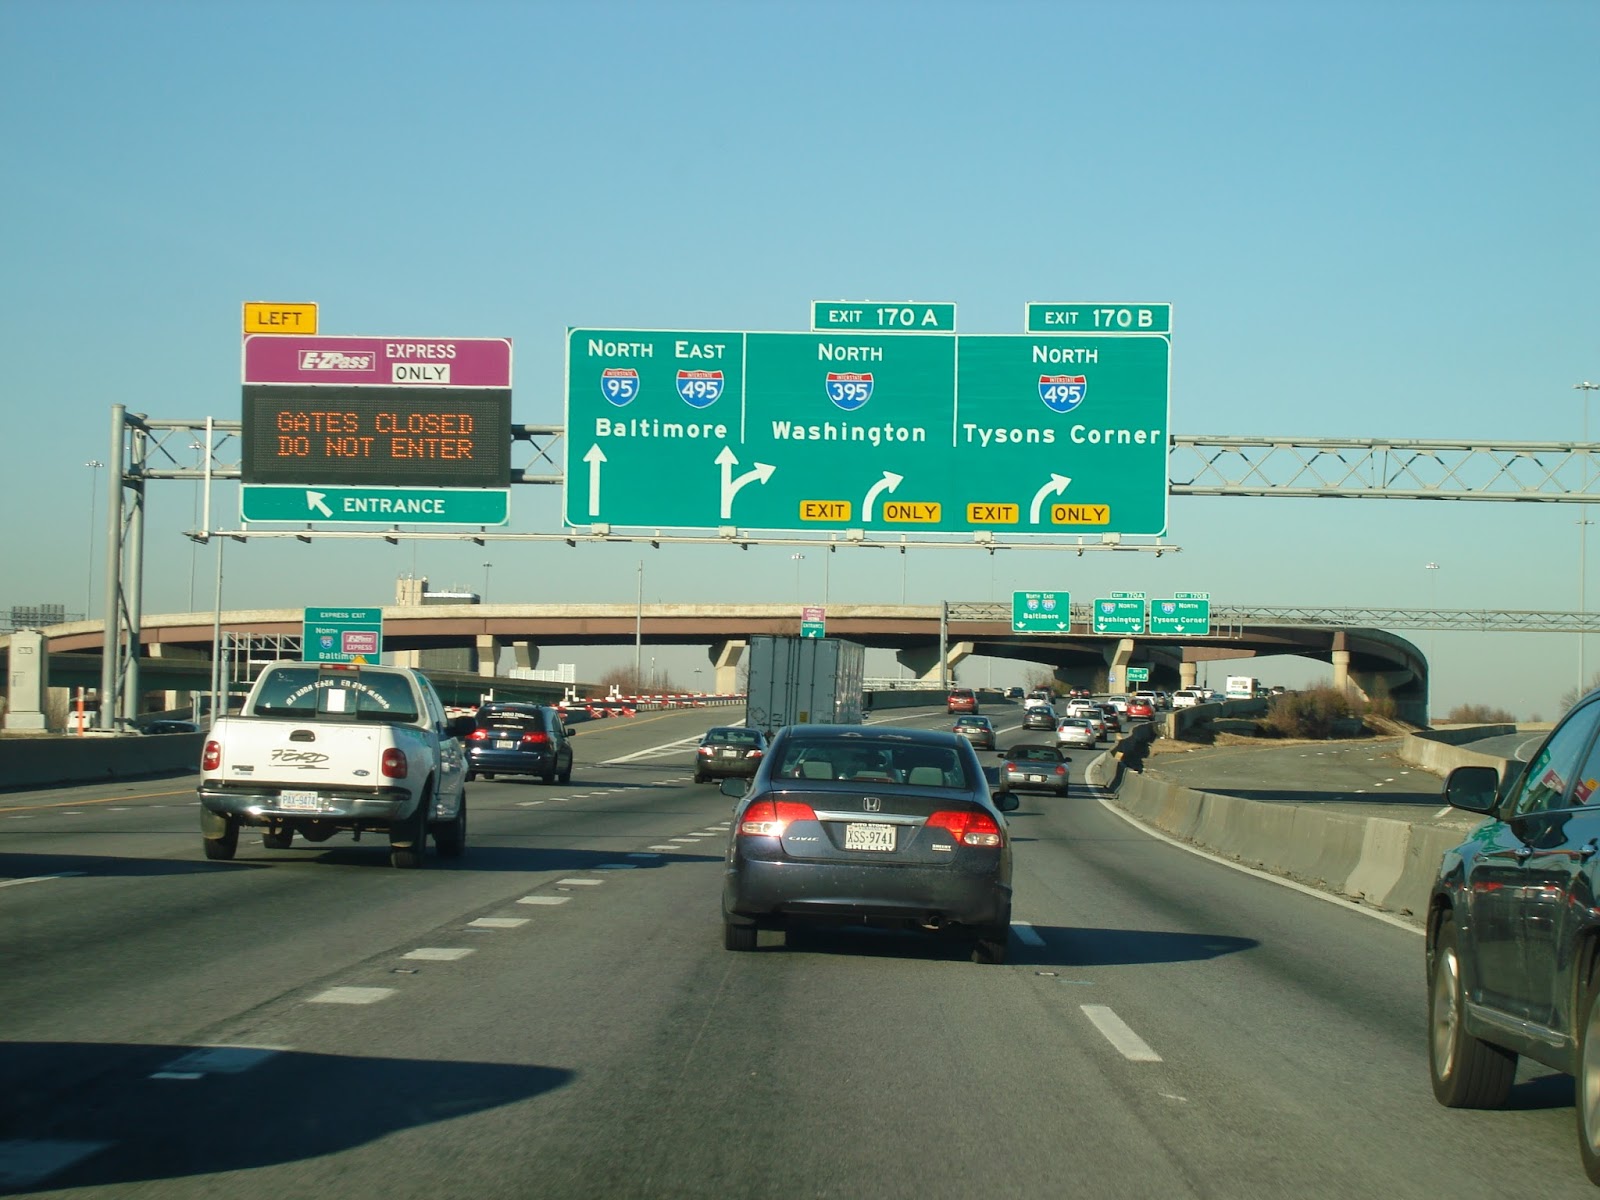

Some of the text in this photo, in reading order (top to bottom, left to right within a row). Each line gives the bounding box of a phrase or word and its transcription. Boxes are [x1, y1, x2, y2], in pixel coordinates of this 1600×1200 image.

[258, 311, 302, 325] LEFT
[829, 308, 938, 326] EXIT 170 A
[1045, 309, 1153, 327] EXIT 170 B
[386, 344, 456, 359] EXPRESS
[588, 339, 725, 359] NORTH EAST
[818, 343, 883, 361] NORTH
[1032, 346, 1098, 363] NORTH
[302, 352, 370, 369] E-ZPass
[396, 366, 446, 380] ONLY
[607, 379, 633, 398] 95
[681, 381, 718, 399] 495
[832, 383, 868, 401] 395
[1044, 385, 1081, 404] 495
[277, 411, 474, 435] GATES CLOSED
[595, 418, 727, 439] Baltimore
[772, 420, 926, 447] Washington
[963, 424, 1160, 447] Tysons Corner
[277, 435, 475, 459] DO NOT ENTER
[343, 498, 445, 514] ENTRANCE
[806, 503, 845, 518] EXIT
[887, 505, 937, 519] ONLY
[973, 506, 1013, 520] EXIT
[1055, 507, 1106, 521] ONLY
[1098, 616, 1141, 624] Washington
[1153, 616, 1179, 624] Tysons
[271, 749, 330, 763] FORD
